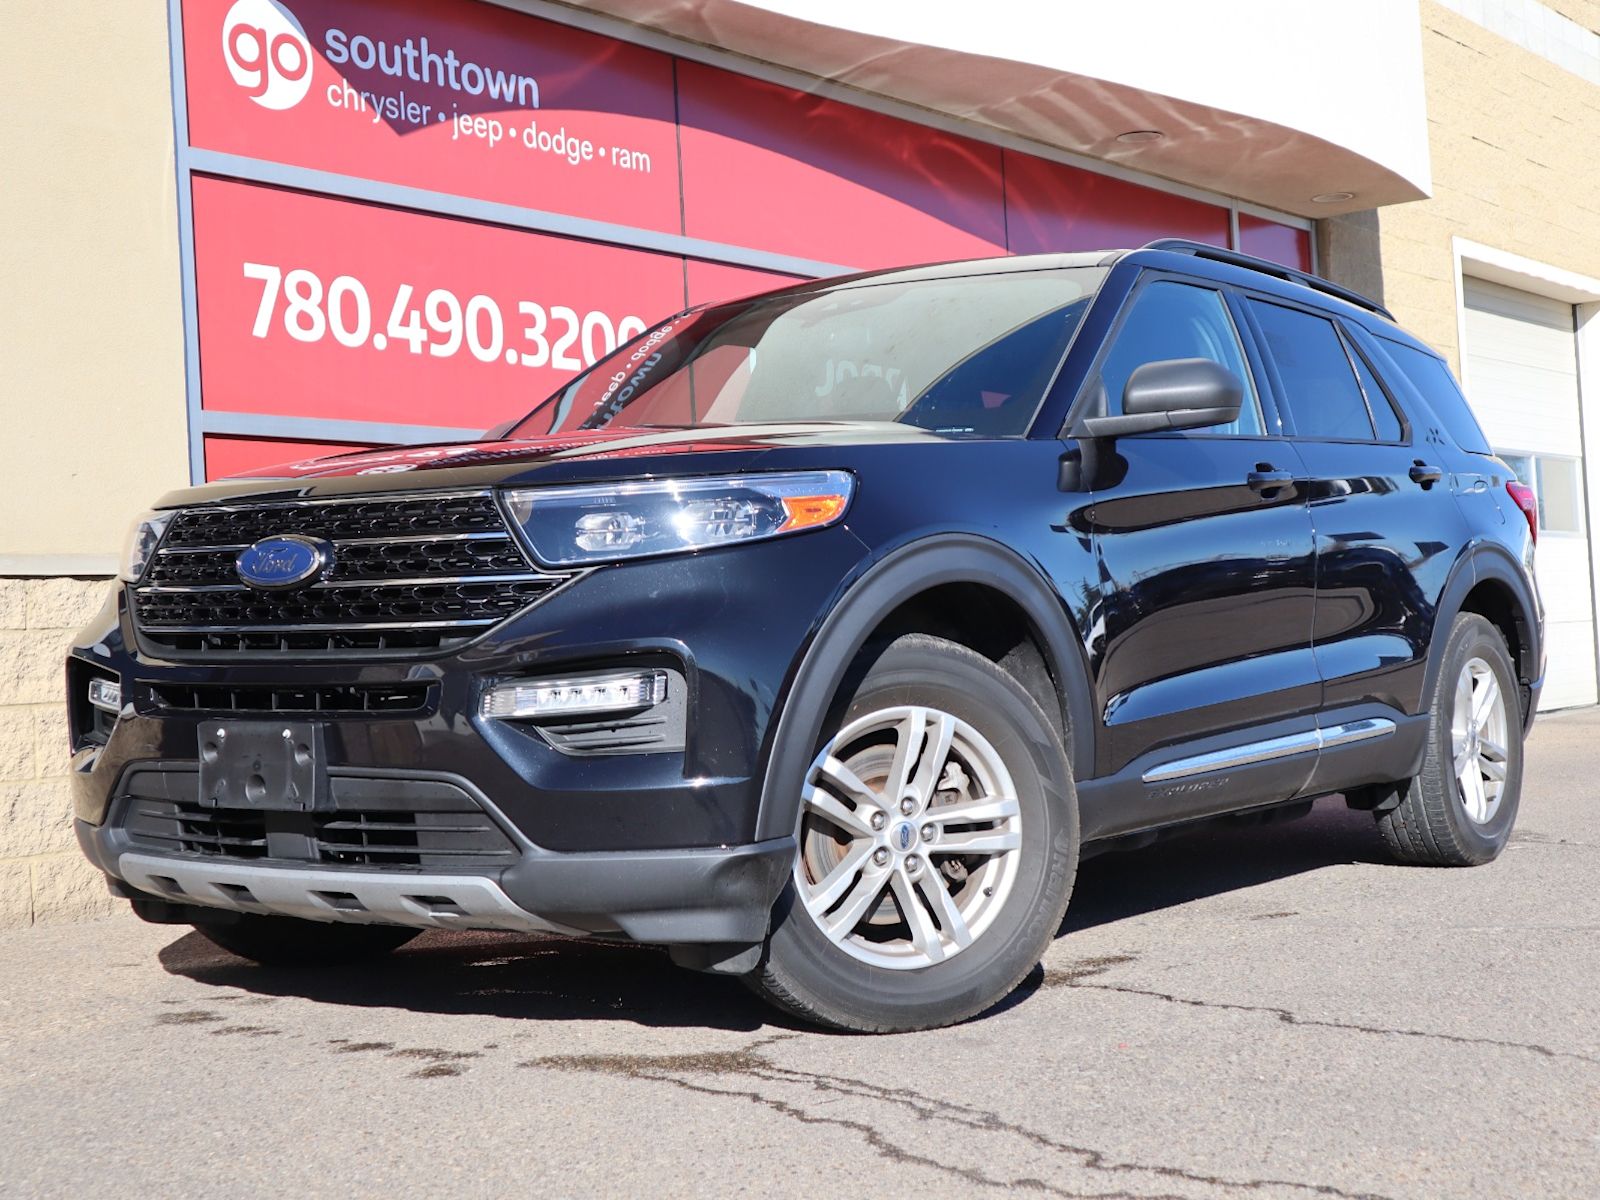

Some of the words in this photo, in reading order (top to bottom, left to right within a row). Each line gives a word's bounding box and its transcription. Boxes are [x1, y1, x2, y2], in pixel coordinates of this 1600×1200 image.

[228, 23, 308, 98] go
[325, 28, 540, 109] southtown
[326, 78, 431, 125] chrysler
[452, 103, 503, 147] jeep
[522, 121, 593, 165] dodge
[611, 146, 651, 173] ram
[252, 548, 298, 574] Ford
